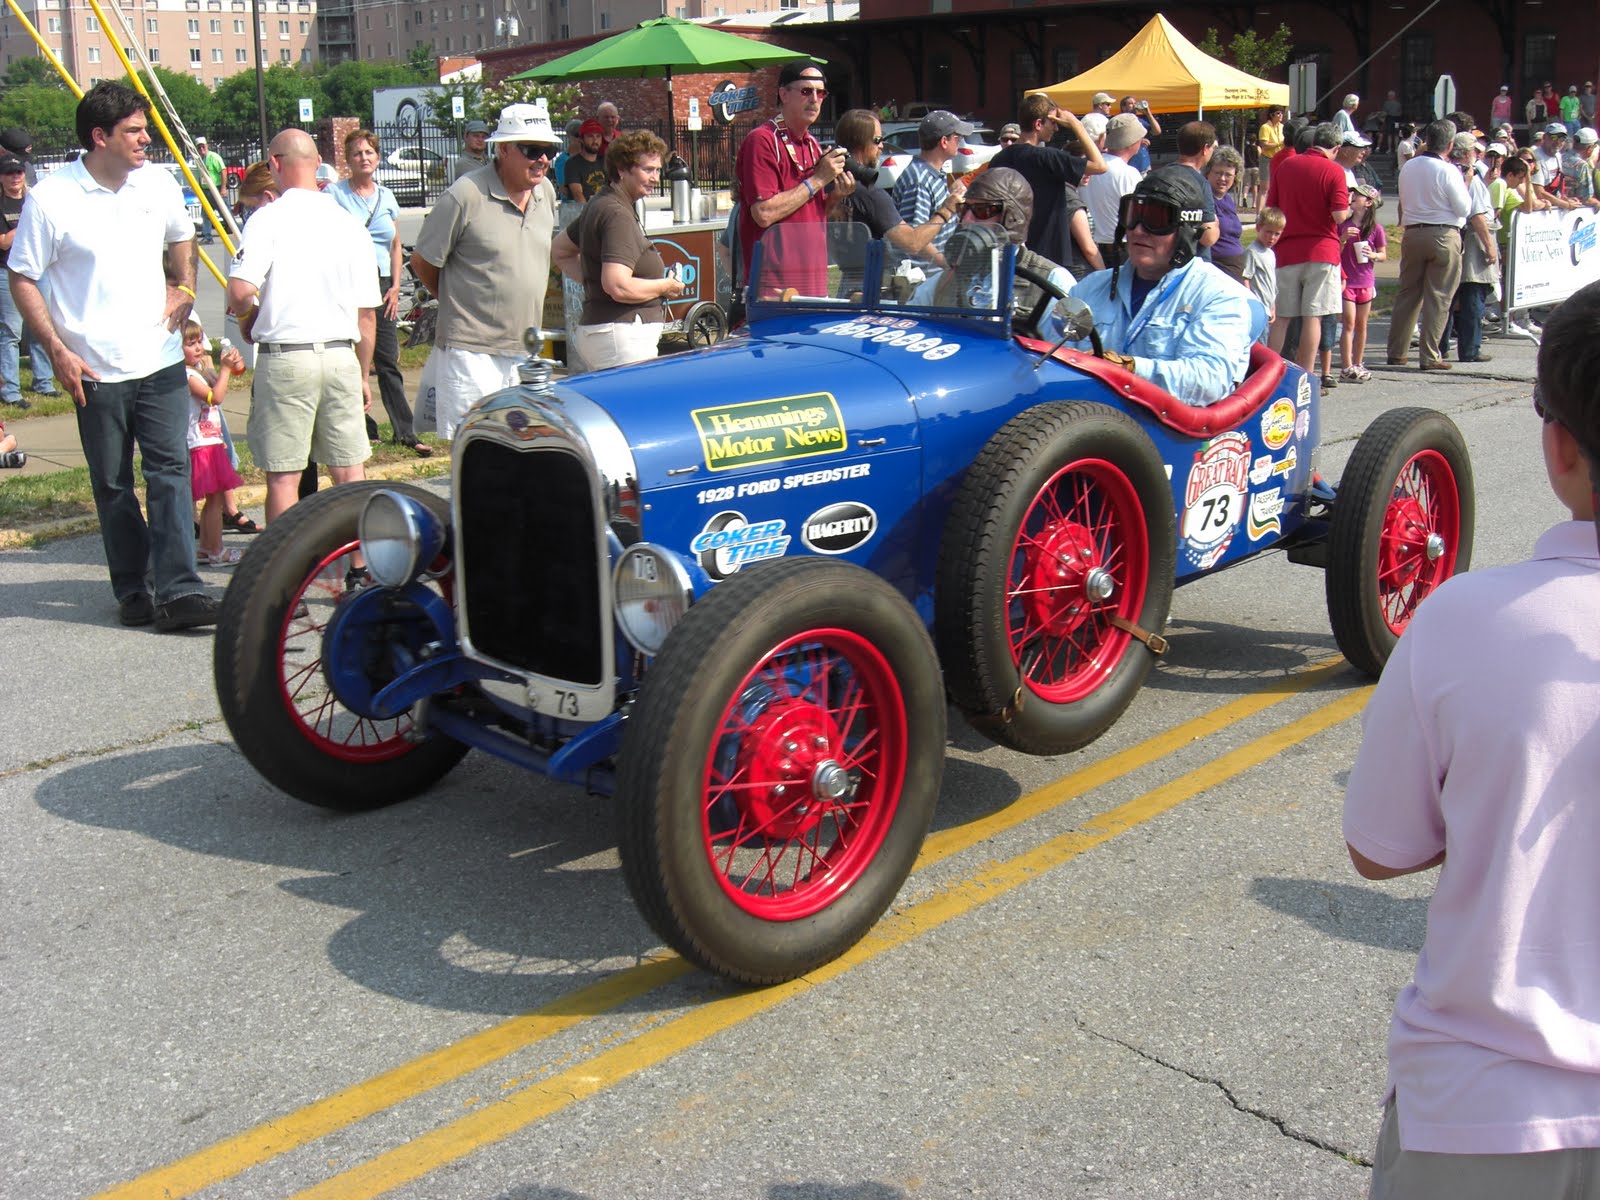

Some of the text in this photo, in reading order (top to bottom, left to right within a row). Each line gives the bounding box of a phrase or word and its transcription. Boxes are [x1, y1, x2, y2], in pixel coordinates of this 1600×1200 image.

[709, 87, 757, 105] COKER
[728, 98, 759, 113] TIRE
[709, 406, 828, 436] Hemmings
[707, 425, 841, 460] Motor News
[696, 463, 871, 504] 1928 FORD SPEEDSTER
[1187, 453, 1250, 507] GREAT RACE
[1200, 494, 1231, 531] 73
[694, 521, 783, 551] COKER
[808, 516, 872, 540] HAGERTY
[726, 537, 788, 565] TIRE
[554, 690, 580, 716] 73
